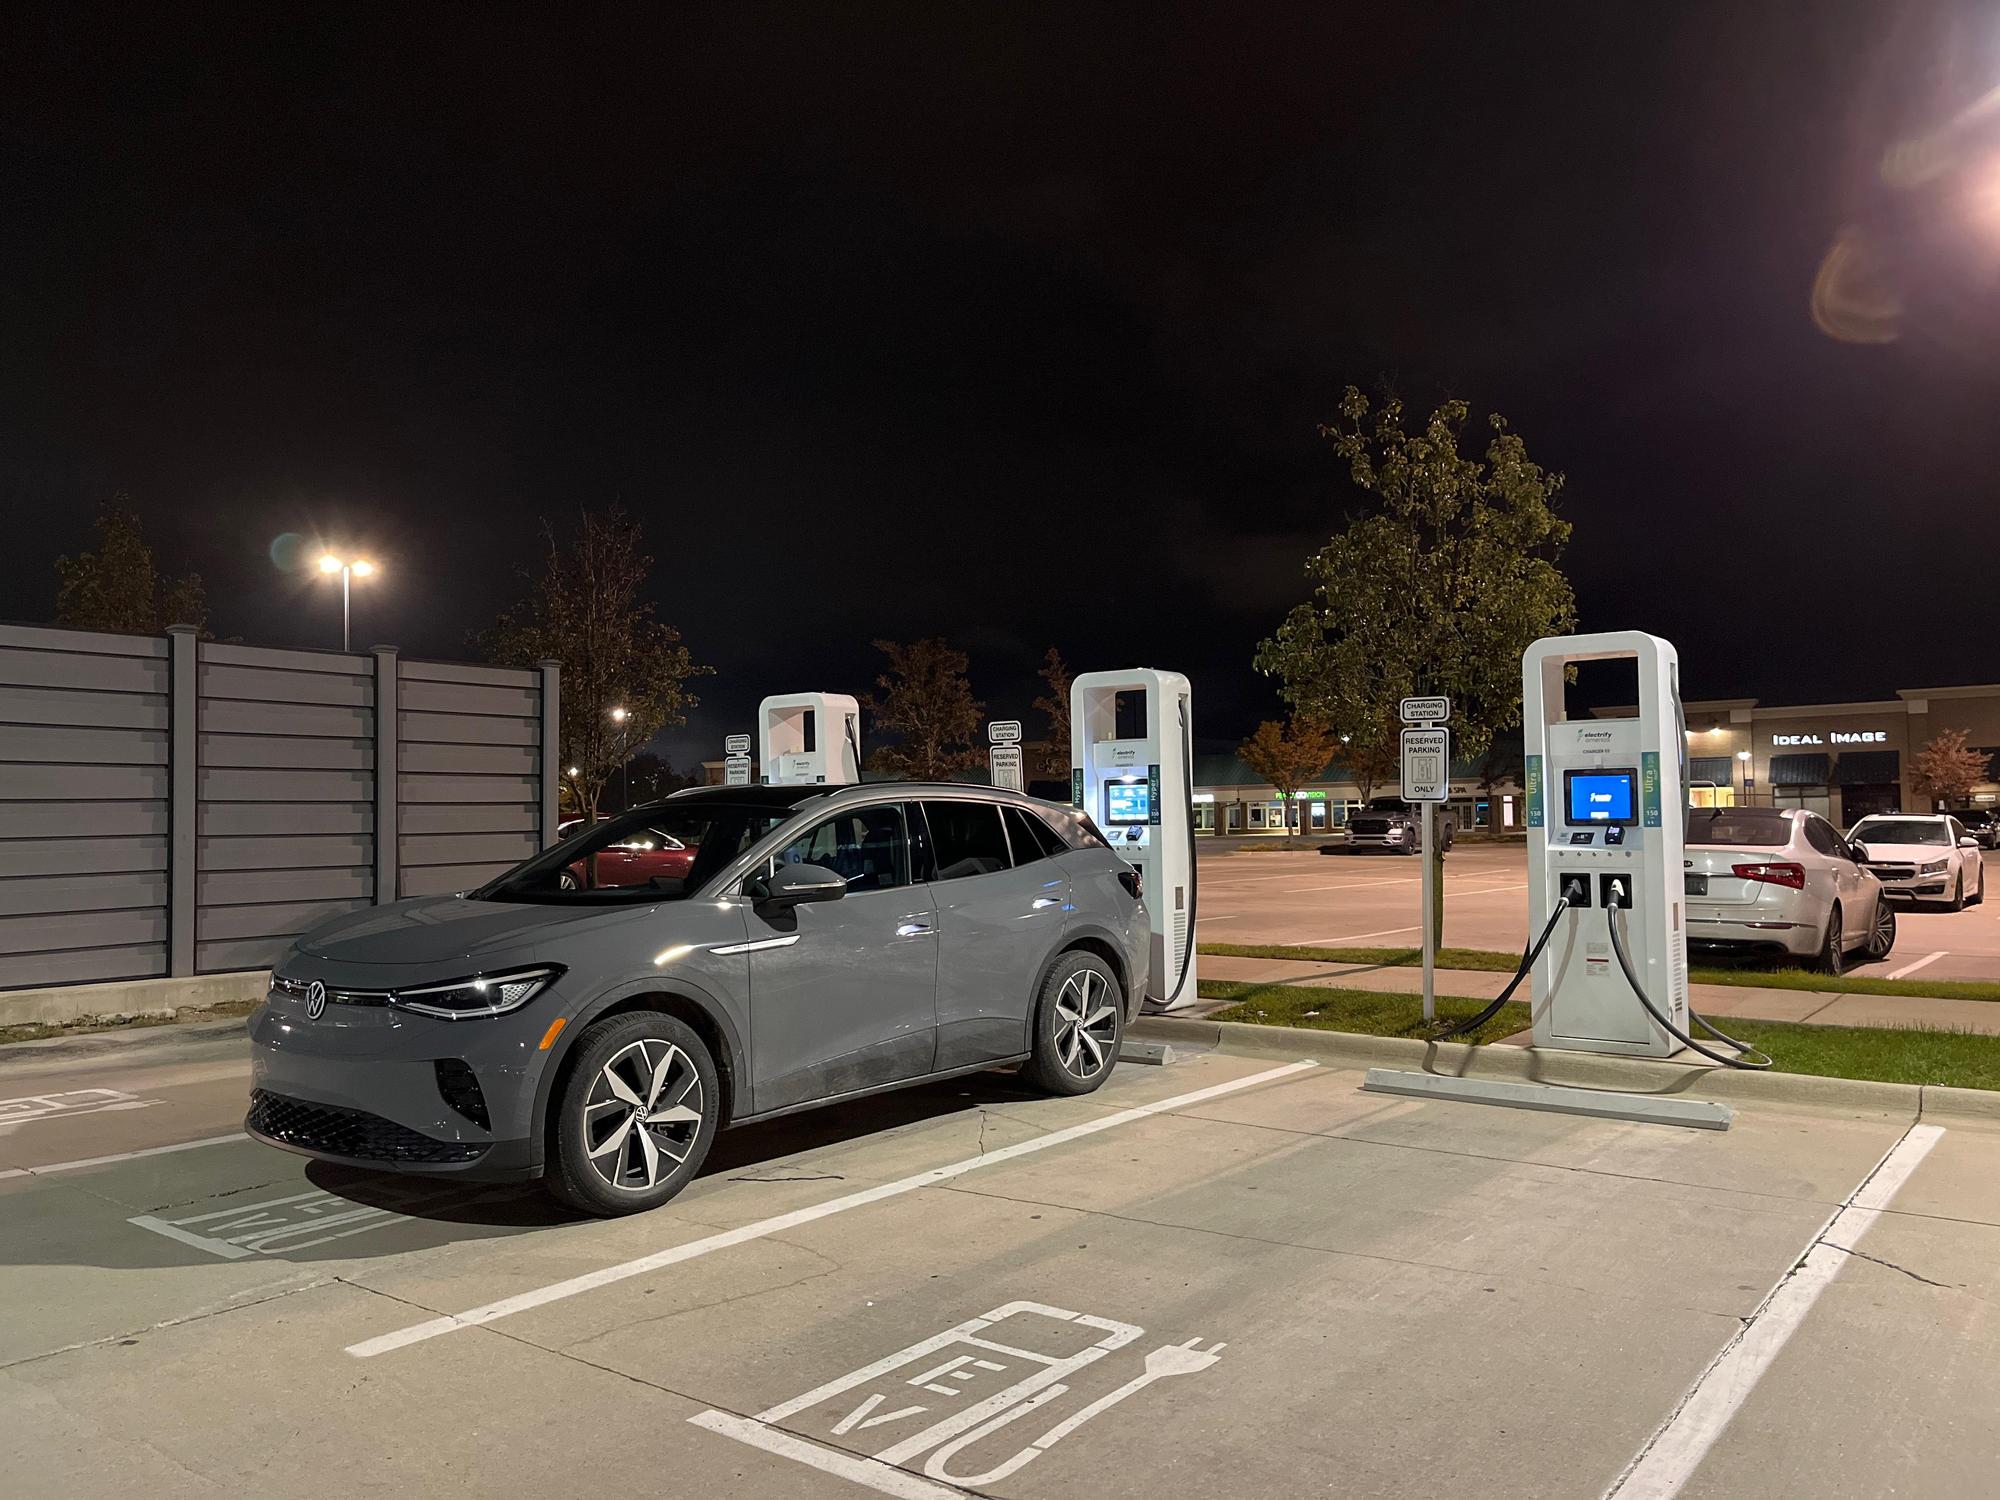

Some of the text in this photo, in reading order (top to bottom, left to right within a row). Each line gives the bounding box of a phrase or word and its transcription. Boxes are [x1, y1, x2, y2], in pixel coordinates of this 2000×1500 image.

[1406, 702, 1443, 710] CHARGING
[1405, 737, 1444, 745] RESERVED
[1773, 731, 1886, 745] IDEAL IMAGE
[1408, 746, 1441, 754] PARKING
[1529, 772, 1537, 794] Ultra
[1645, 770, 1653, 793] Ultra
[1414, 785, 1435, 793] ONLY
[830, 1354, 1008, 1436] EV
